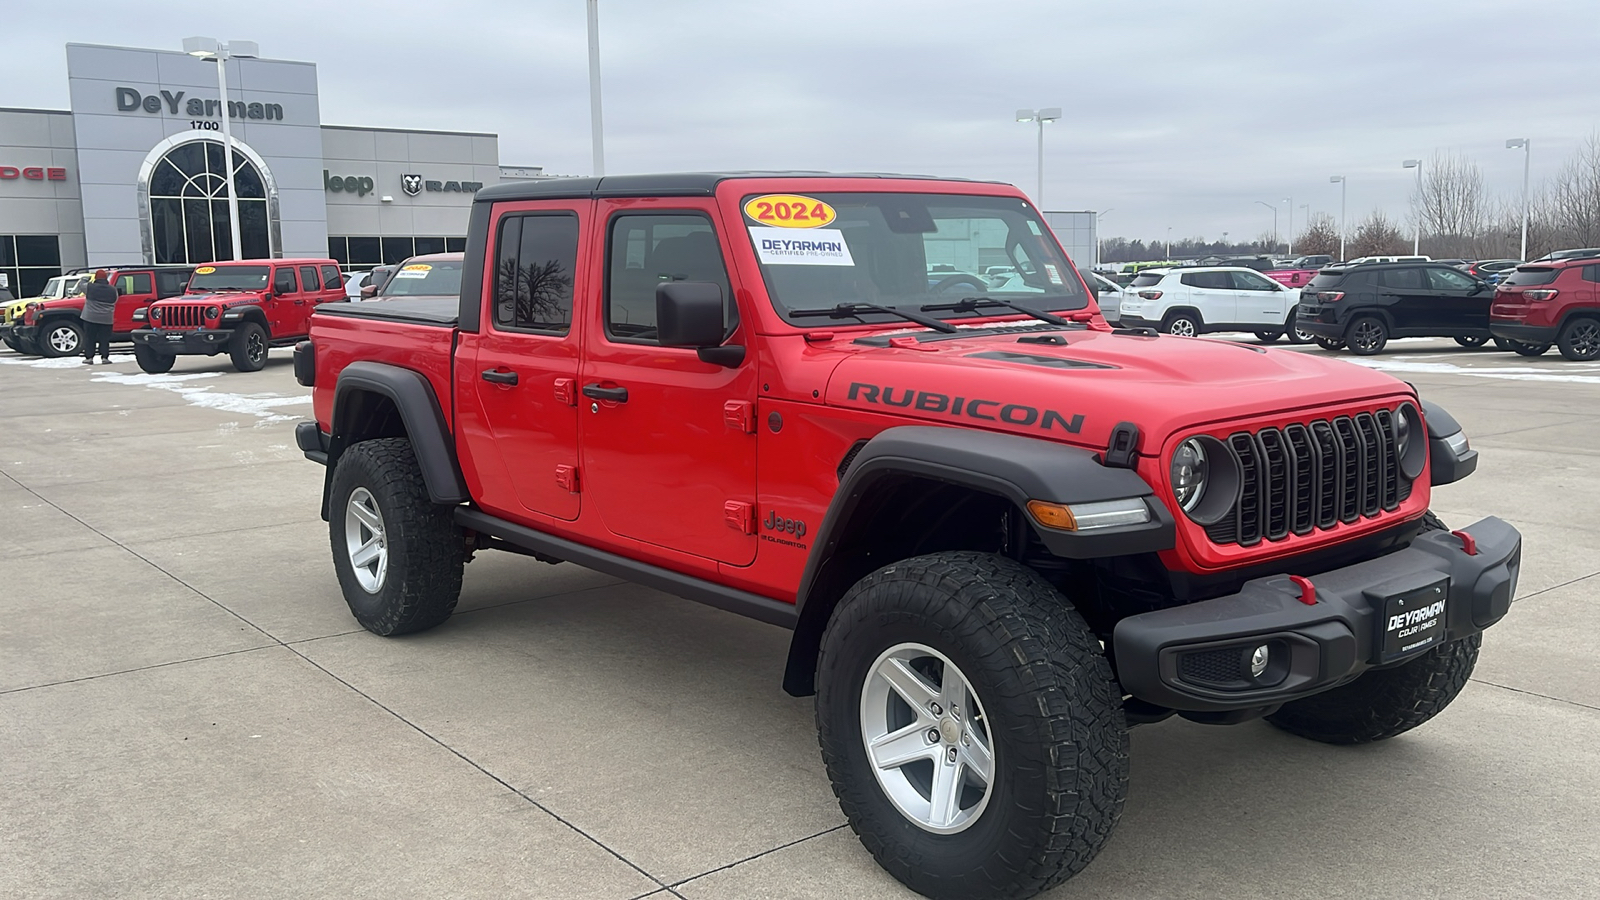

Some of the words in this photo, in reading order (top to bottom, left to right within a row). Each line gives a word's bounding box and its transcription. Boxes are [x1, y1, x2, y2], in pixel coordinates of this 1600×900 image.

[116, 87, 283, 121] DeYarman
[190, 120, 219, 131] 1700
[425, 180, 483, 192] RAM
[756, 202, 828, 221] 2024
[762, 239, 842, 252] DEYARMAN
[848, 382, 1086, 434] RUBICON
[763, 509, 807, 540] Jeep
[767, 535, 807, 550] GLADIATOR
[1387, 599, 1446, 632] DEYARMAN
[1420, 618, 1438, 631] AMES
